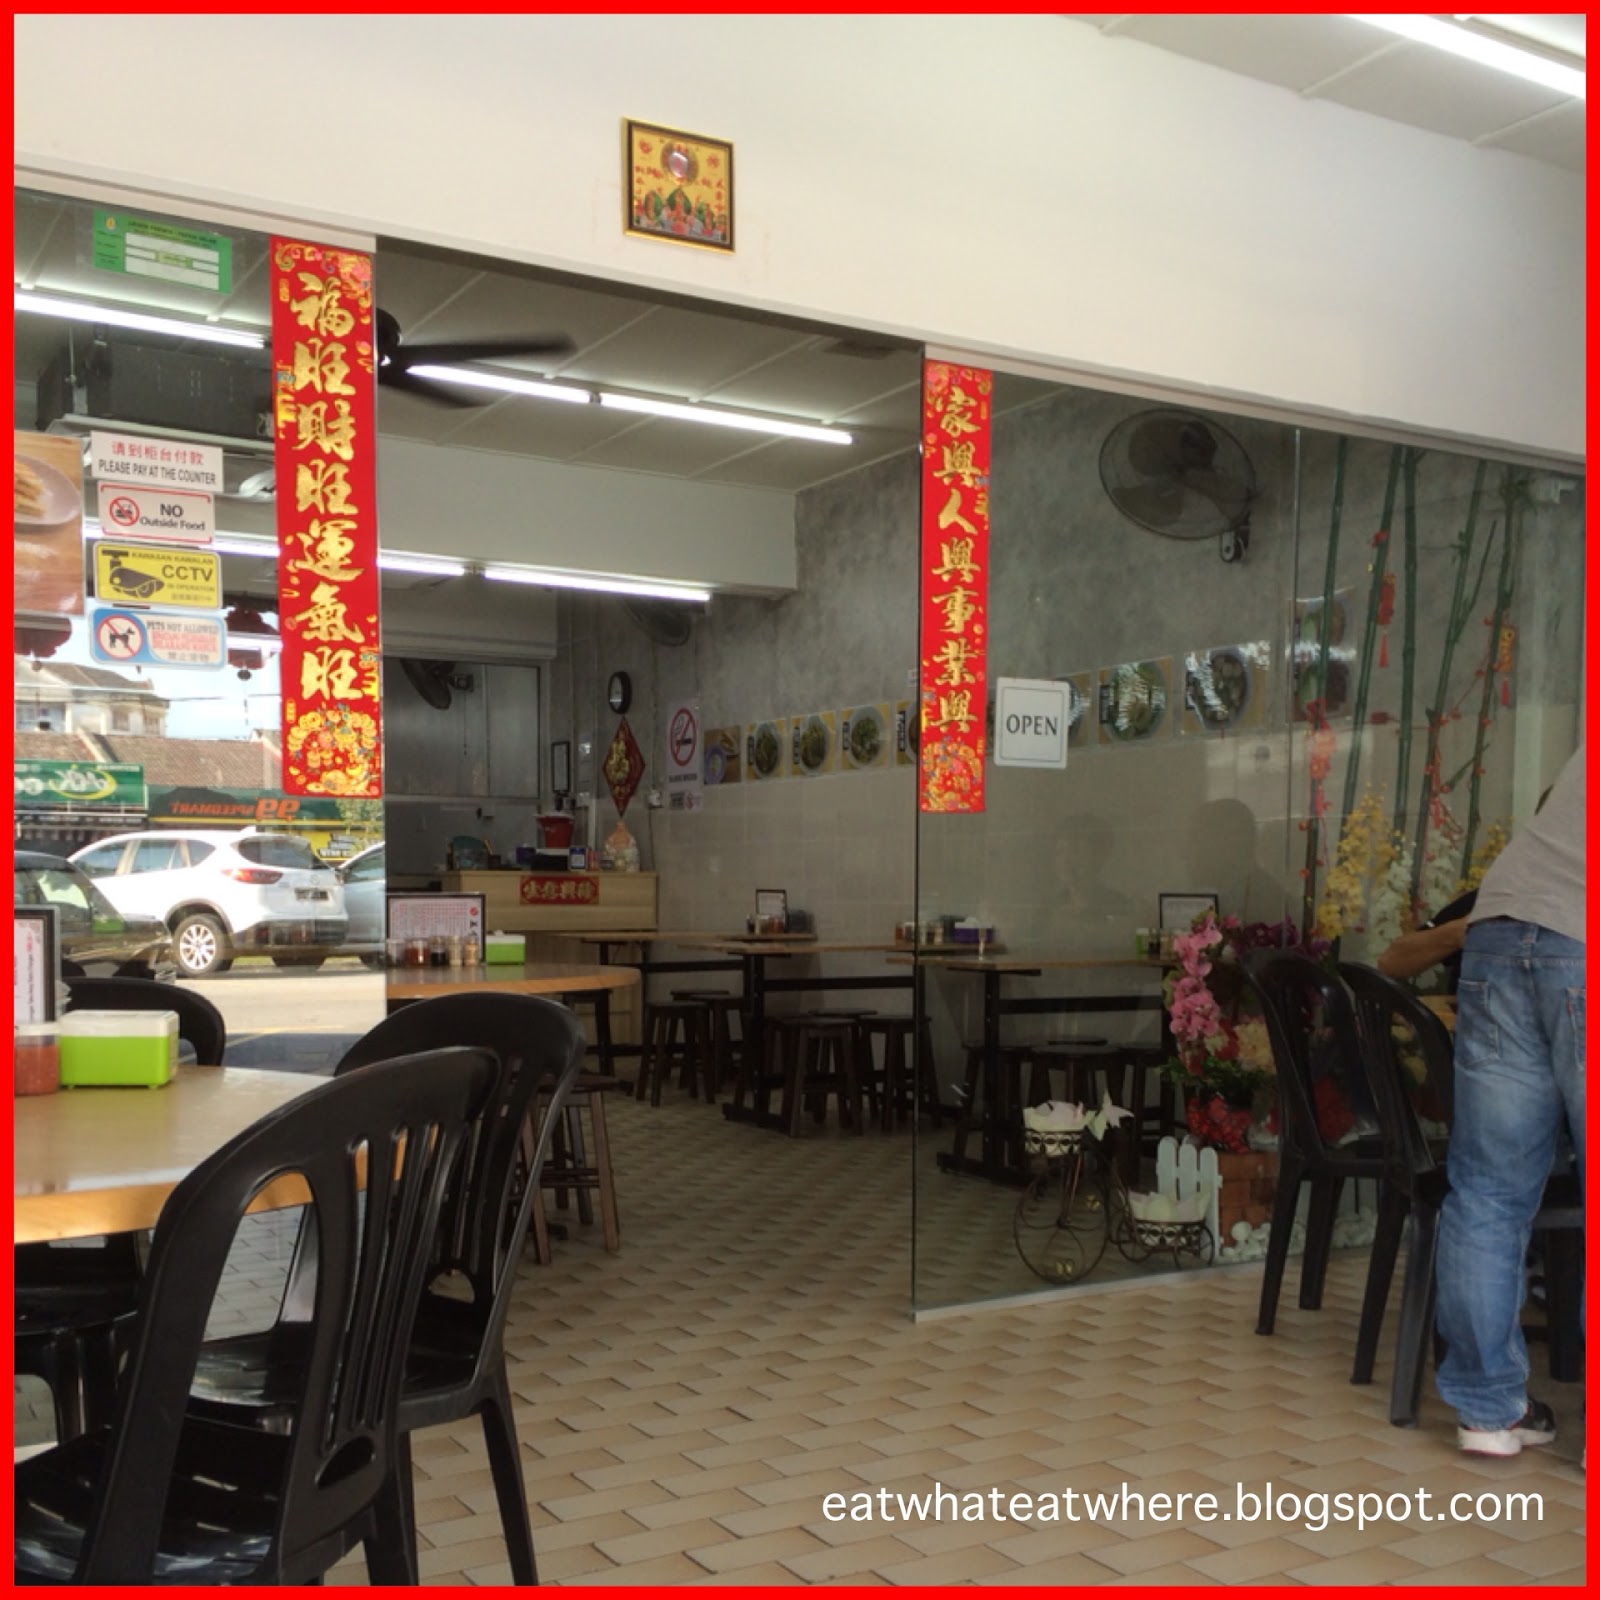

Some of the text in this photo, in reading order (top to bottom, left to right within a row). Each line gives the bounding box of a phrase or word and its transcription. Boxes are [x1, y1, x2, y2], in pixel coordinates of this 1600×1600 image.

[112, 441, 204, 465] 请到柜台付款
[98, 459, 216, 484] PLEASE PAY AT THE COUNTER
[290, 271, 365, 700] 福旺財旺運氣旺
[160, 503, 184, 517] NO
[140, 517, 205, 531] Outside Food
[131, 551, 172, 561] KAWASAN
[930, 385, 981, 733] 家興人興事業興
[161, 564, 214, 582] CCTV
[176, 584, 215, 592] OPERATION
[147, 621, 219, 634] PETS NOT ALLOWED
[1006, 713, 1059, 736] OPEN
